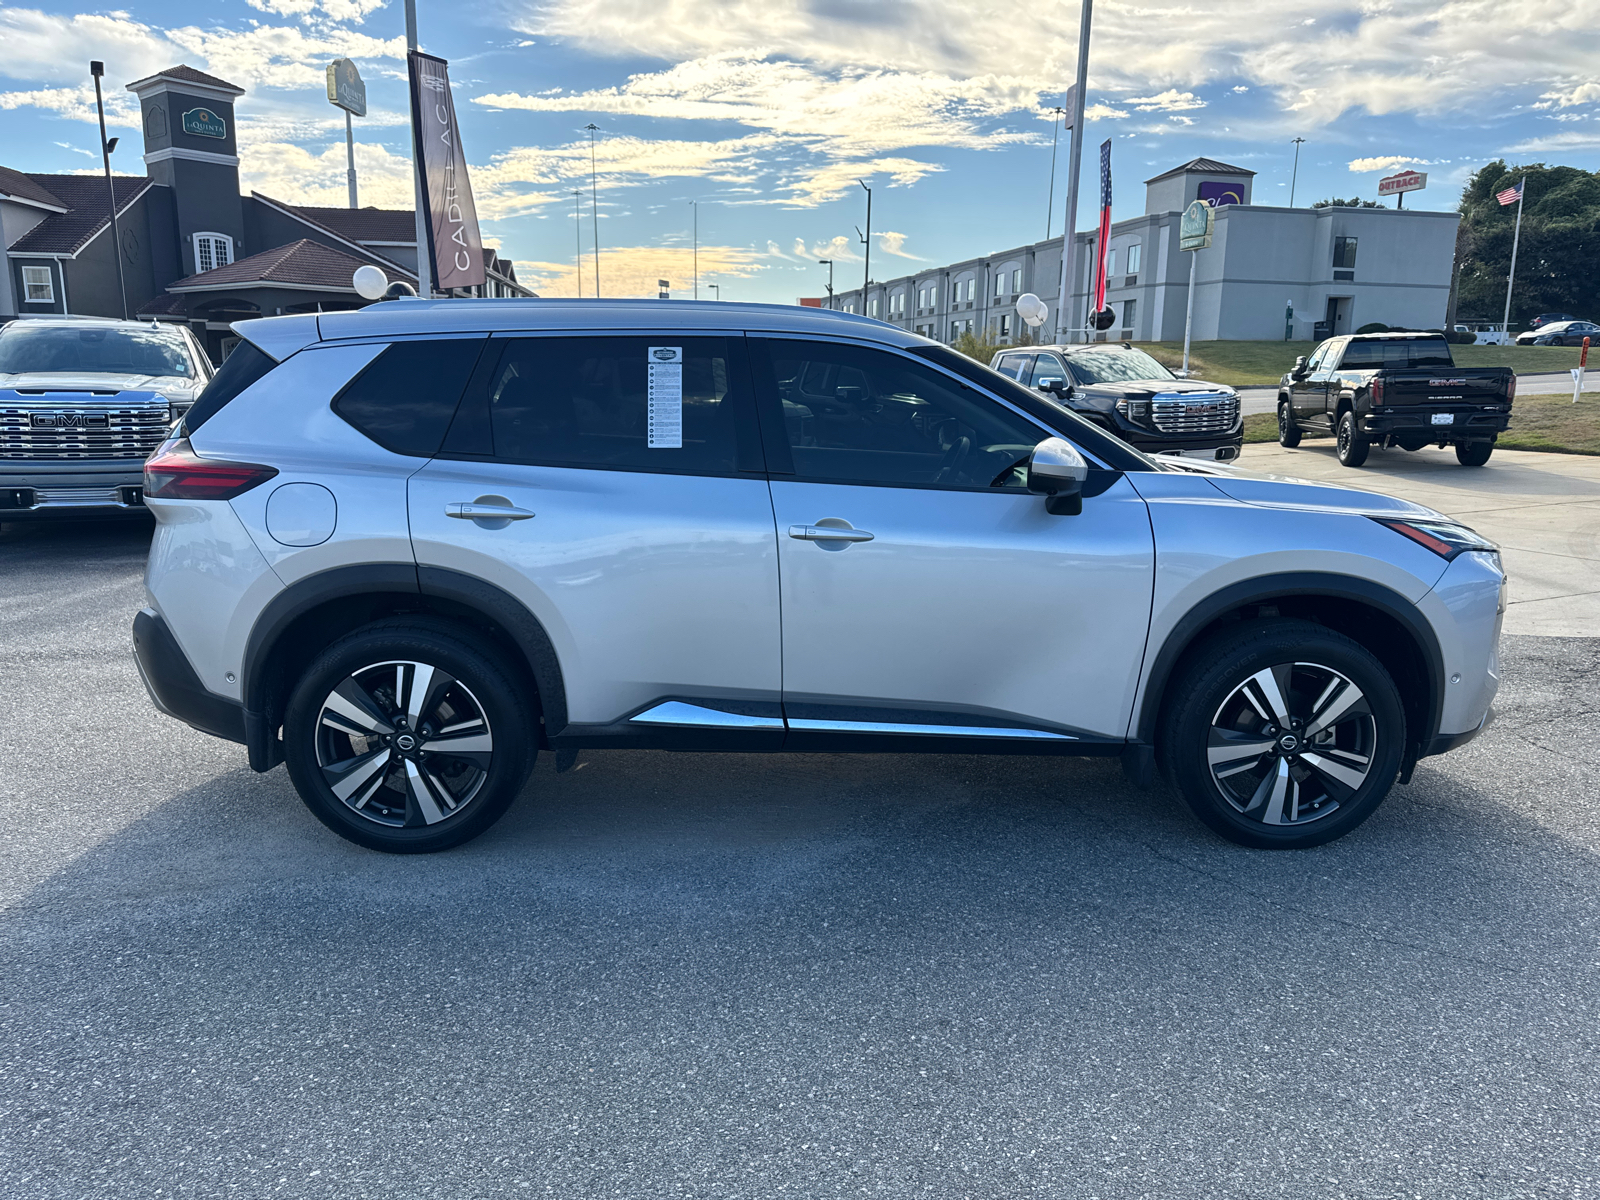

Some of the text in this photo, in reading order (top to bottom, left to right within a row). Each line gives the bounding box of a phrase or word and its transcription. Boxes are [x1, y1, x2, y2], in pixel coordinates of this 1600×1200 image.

[193, 121, 223, 133] QUINTA
[435, 104, 470, 272] CADILLAC
[1379, 176, 1420, 191] OUTBACK
[1186, 404, 1218, 413] GMC
[33, 414, 106, 427] GMC
[1195, 653, 1257, 715] CROSSOVER
